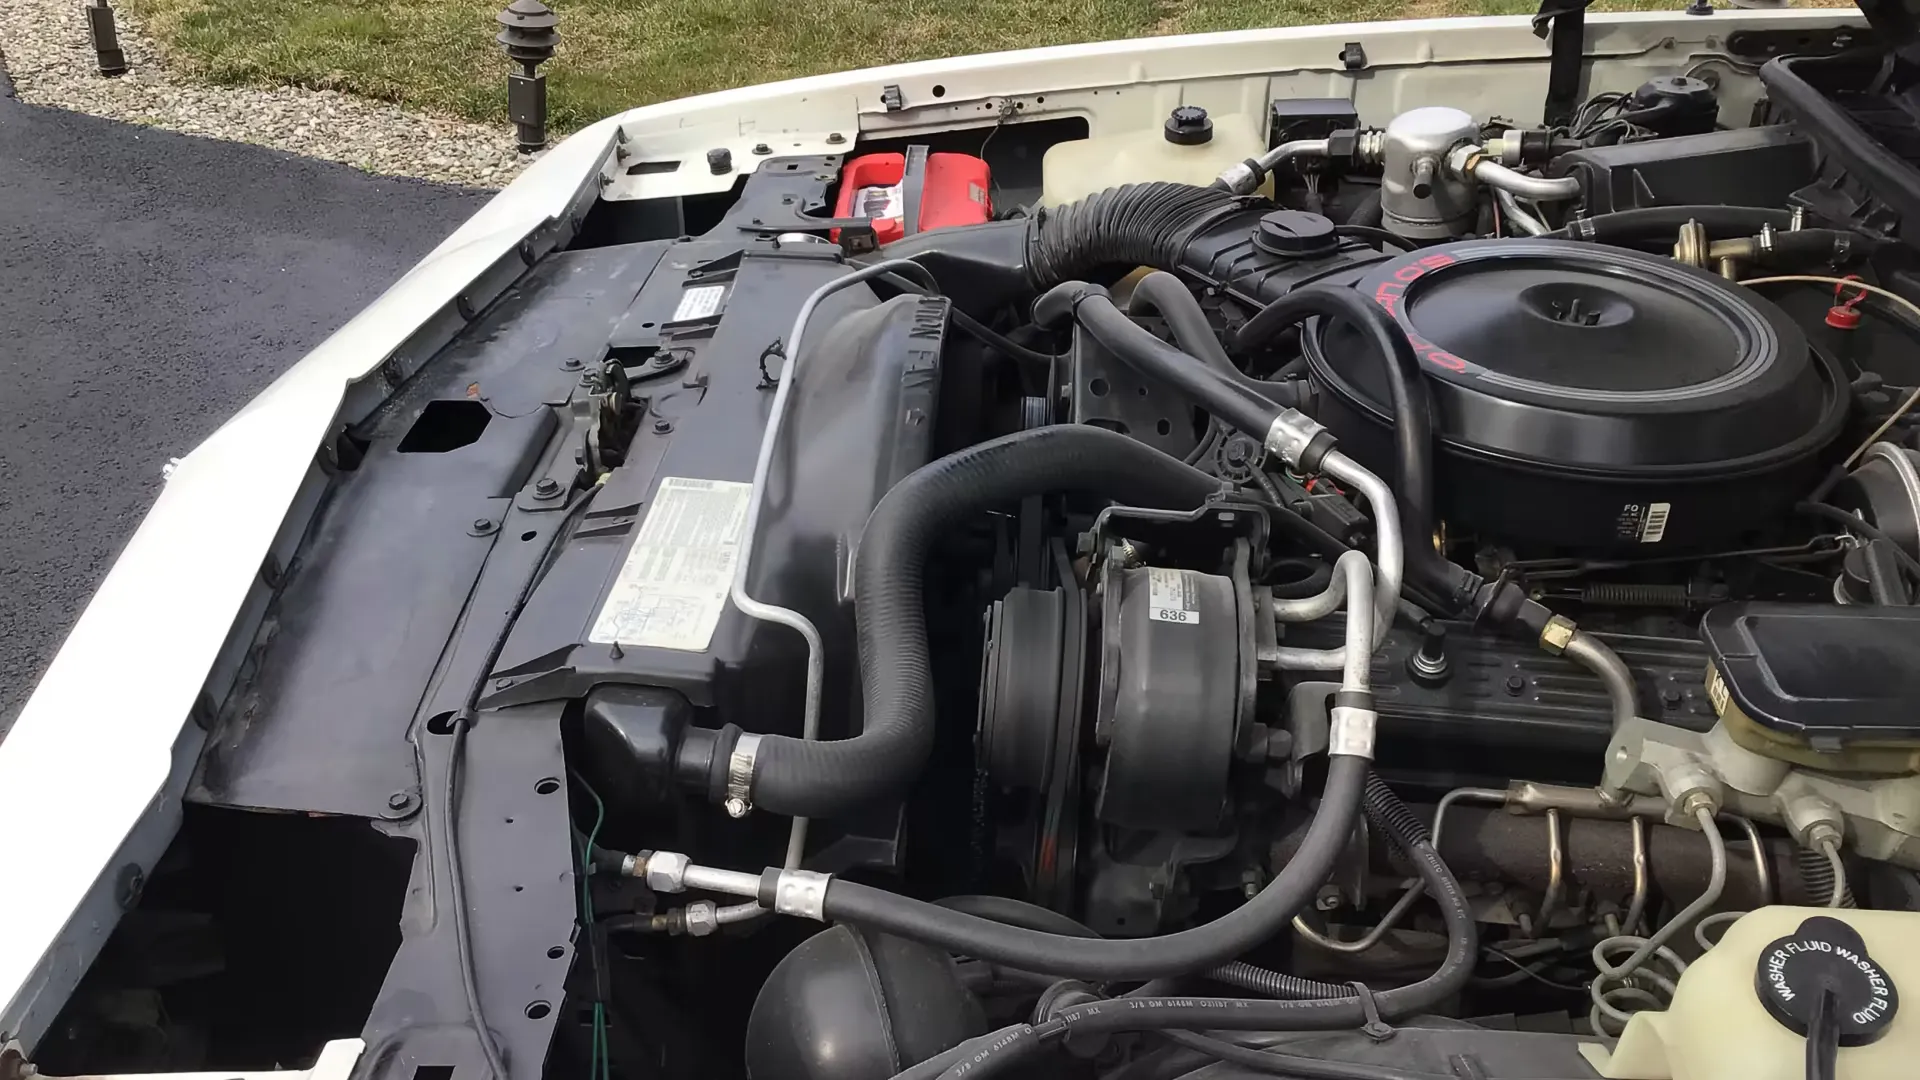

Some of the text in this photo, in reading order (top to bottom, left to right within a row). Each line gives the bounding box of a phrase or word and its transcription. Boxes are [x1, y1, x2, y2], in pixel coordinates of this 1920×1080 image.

[1624, 504, 1639, 512] FO
[1160, 609, 1187, 622] 636
[1768, 940, 1832, 1002] WASHER FLUID
[1836, 946, 1889, 1024] WASHER FLUID
[974, 1049, 990, 1063] GM
[1148, 1000, 1163, 1008] GM
